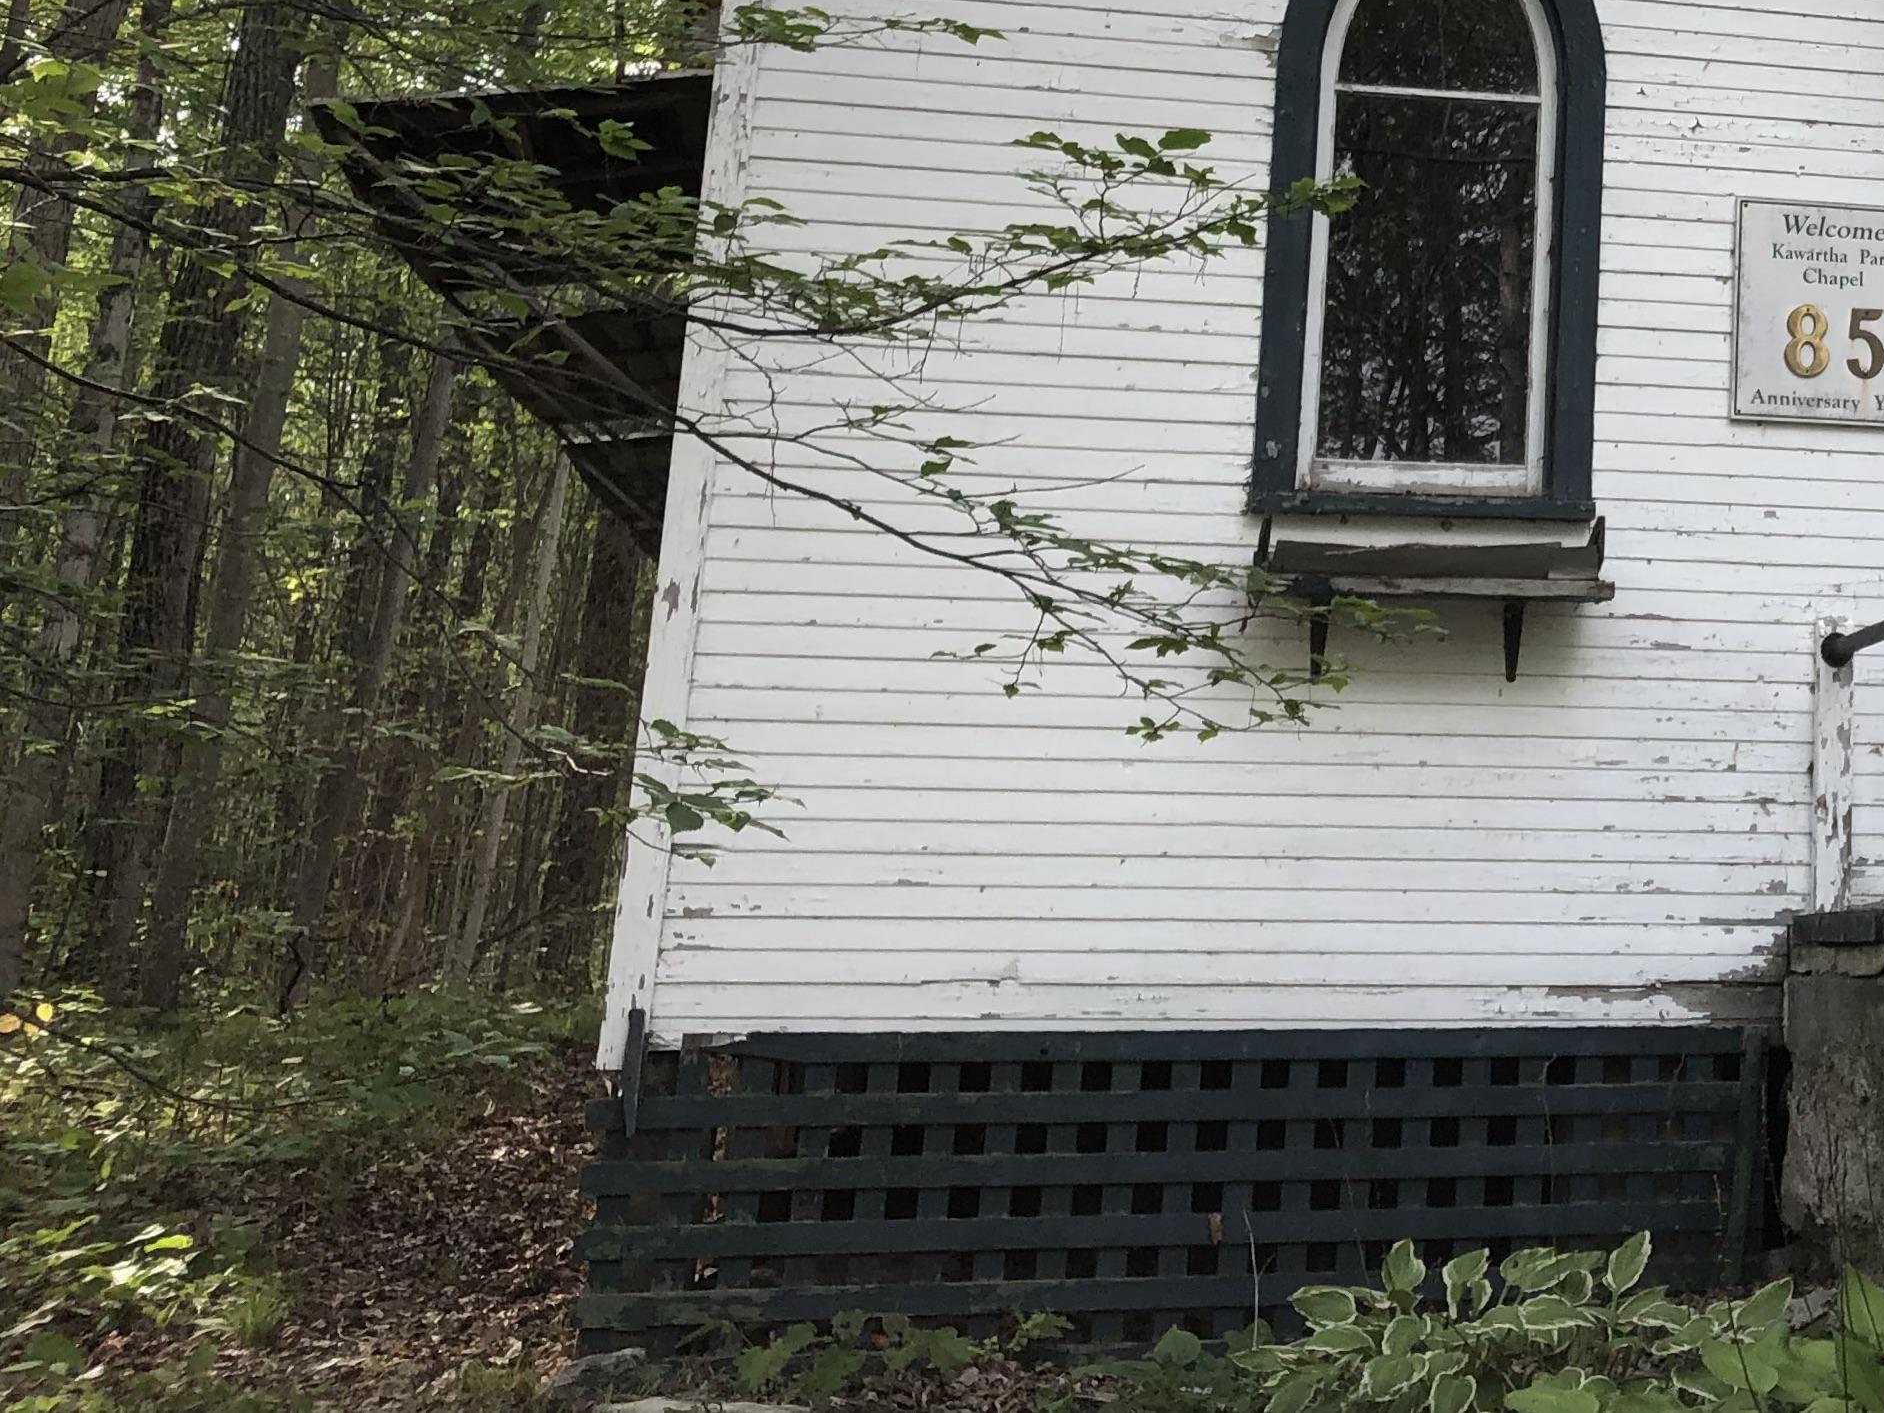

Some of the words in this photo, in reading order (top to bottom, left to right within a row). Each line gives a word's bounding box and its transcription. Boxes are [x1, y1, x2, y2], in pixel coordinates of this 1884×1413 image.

[1772, 243, 1847, 264] Kawartha
[1803, 268, 1864, 289] Chapel
[1751, 389, 1861, 412] Anniversary
